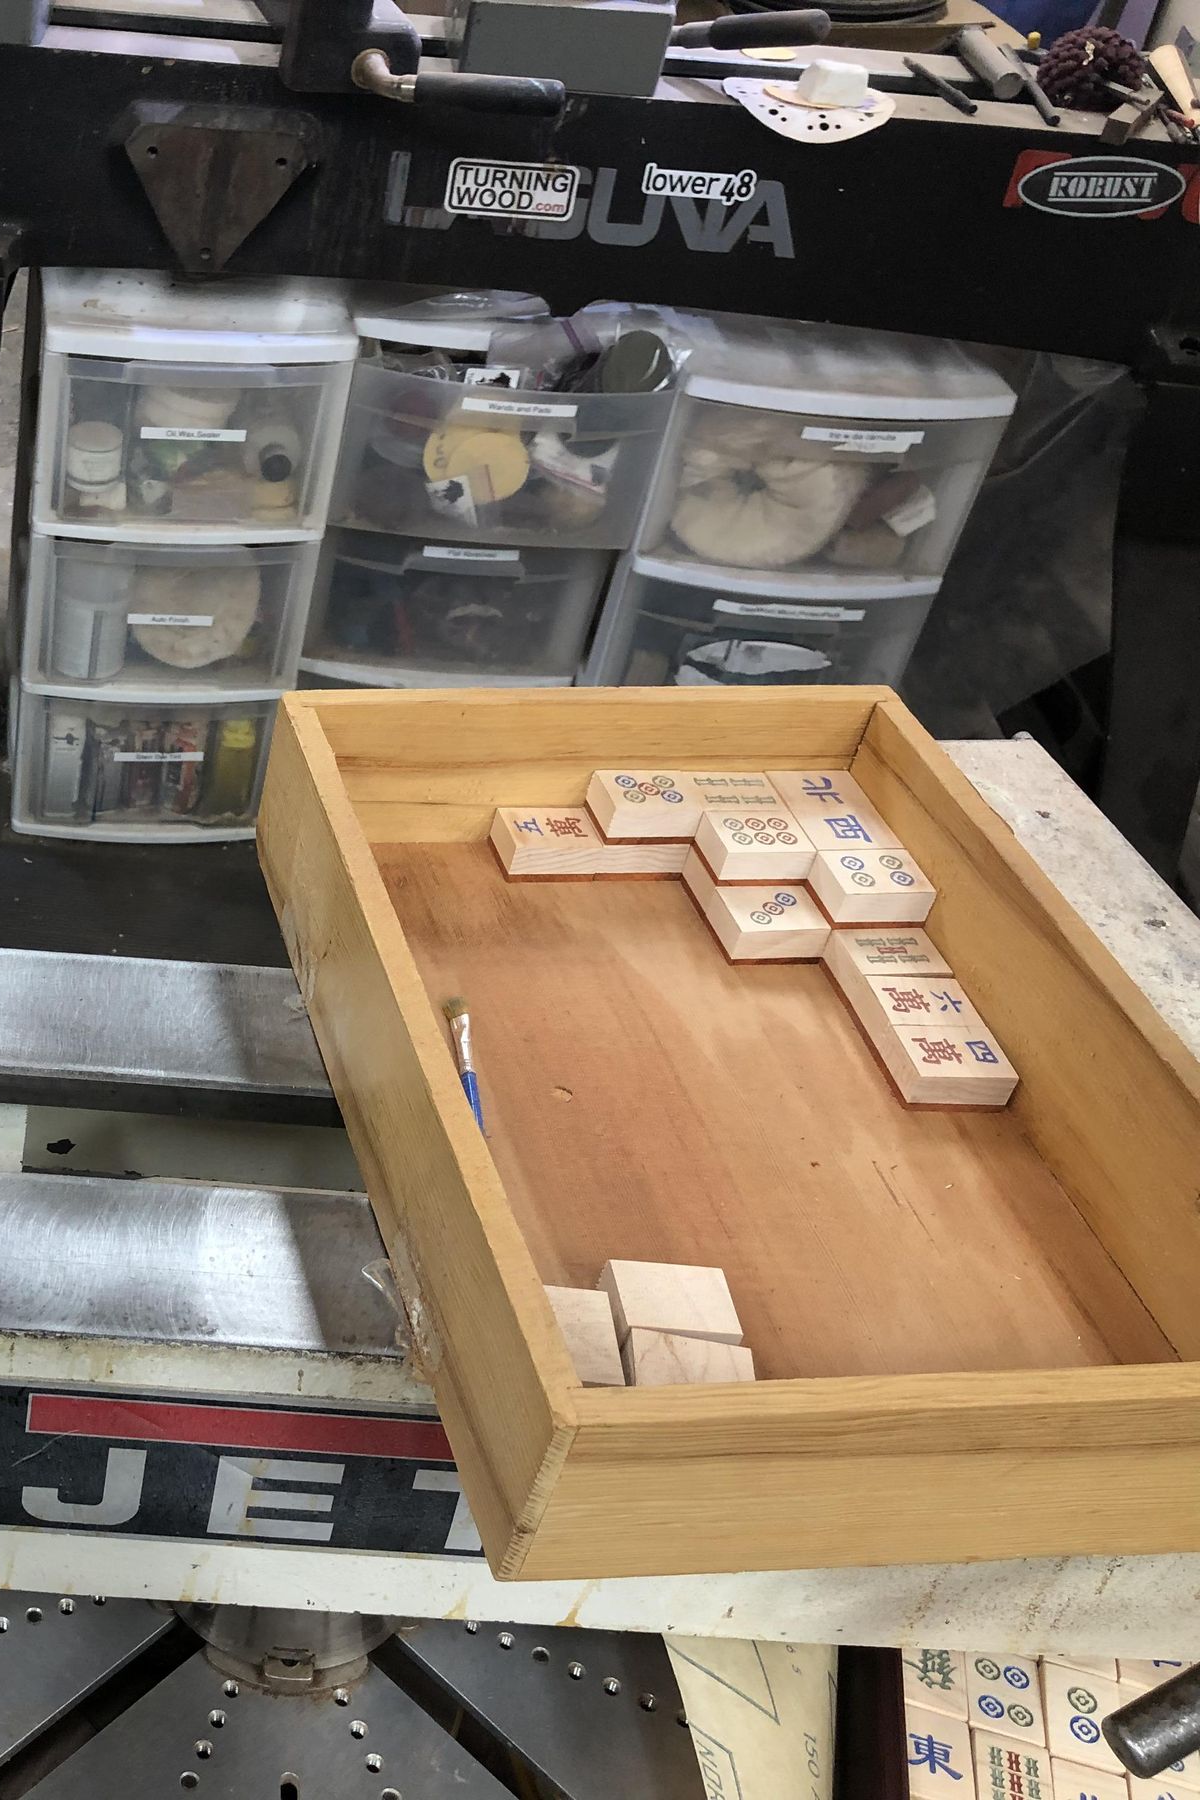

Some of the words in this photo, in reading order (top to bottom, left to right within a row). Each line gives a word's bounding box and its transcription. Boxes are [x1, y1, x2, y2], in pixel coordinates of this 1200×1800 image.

[458, 166, 569, 193] TURNING
[1049, 176, 1158, 198] ROBUST
[384, 151, 796, 258] LUNA
[908, 1733, 963, 1780] 東
